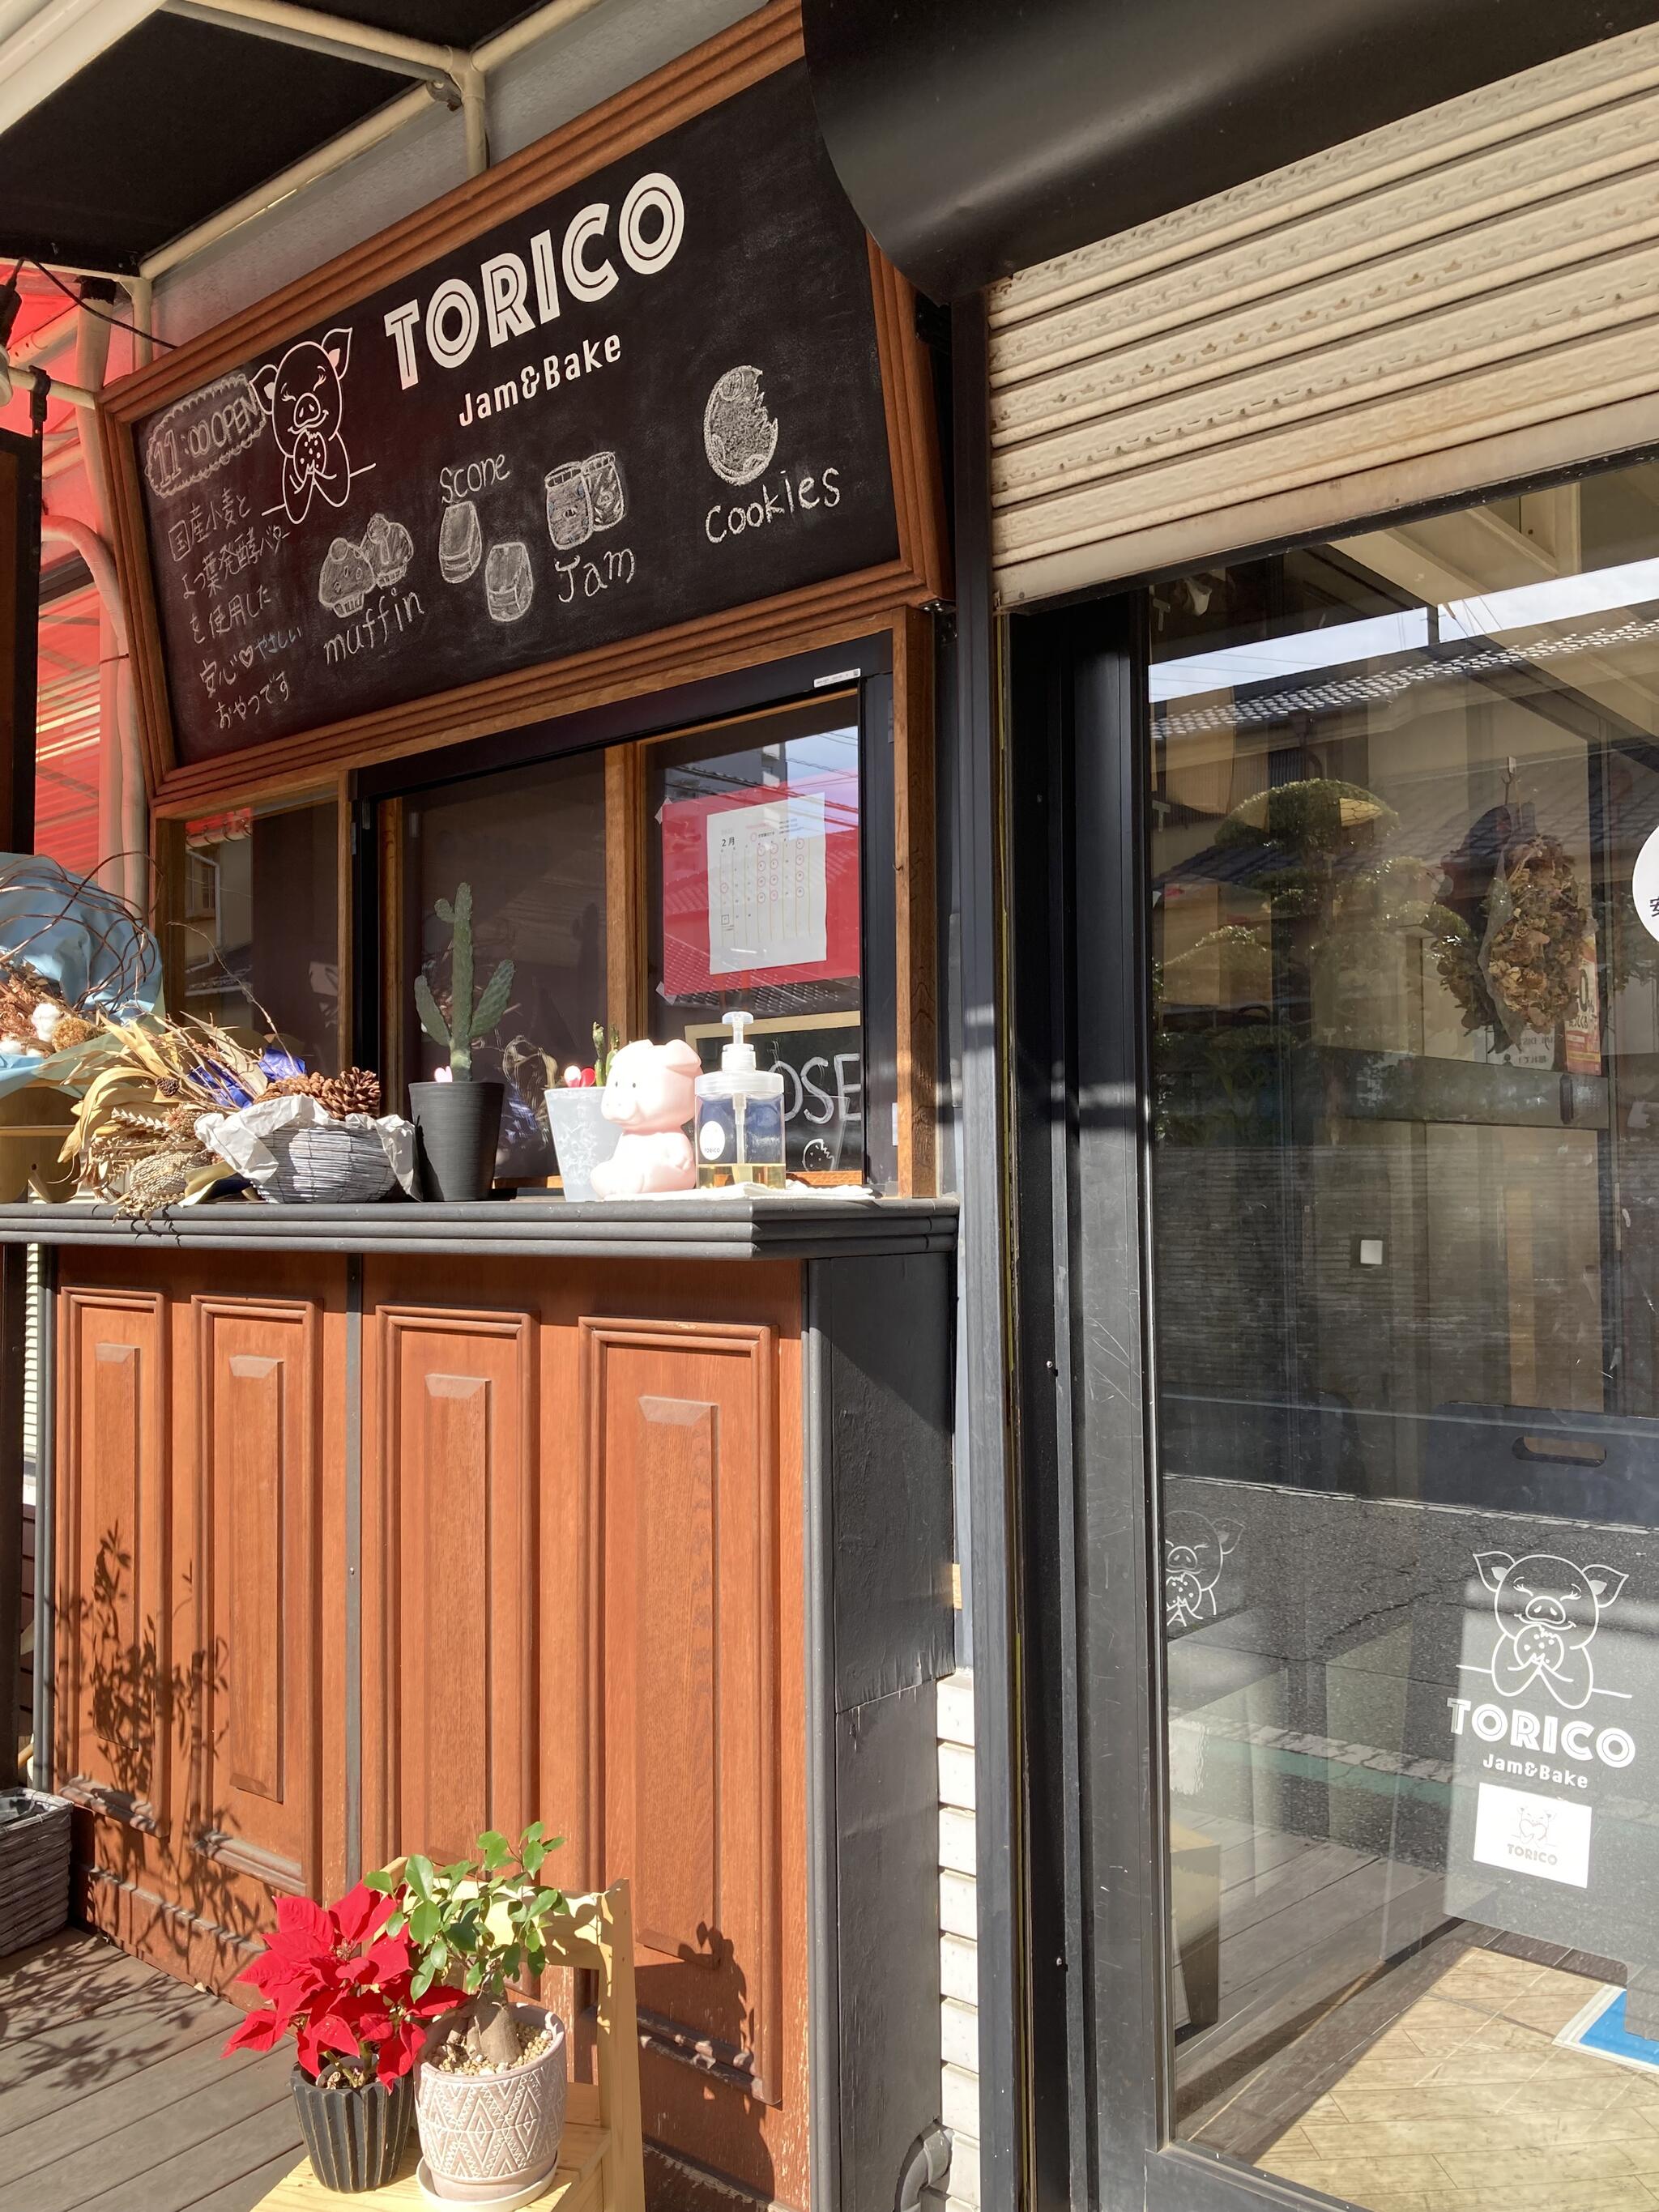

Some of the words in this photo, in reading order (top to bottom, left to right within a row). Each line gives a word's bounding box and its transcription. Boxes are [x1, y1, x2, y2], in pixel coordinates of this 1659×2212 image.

[383, 172, 685, 390] TORICO
[458, 334, 622, 427] Jam&Bake
[168, 488, 252, 562] 国産小麦と
[555, 548, 635, 603] Jam
[189, 584, 271, 644] を使用した
[322, 587, 425, 665] muffin
[215, 671, 290, 729] おやつです
[767, 1053, 862, 1124] OSE
[1447, 1697, 1636, 1769] TORICO
[1482, 1753, 1589, 1789] Jam&Bake
[1507, 1843, 1559, 1866] TORICO
